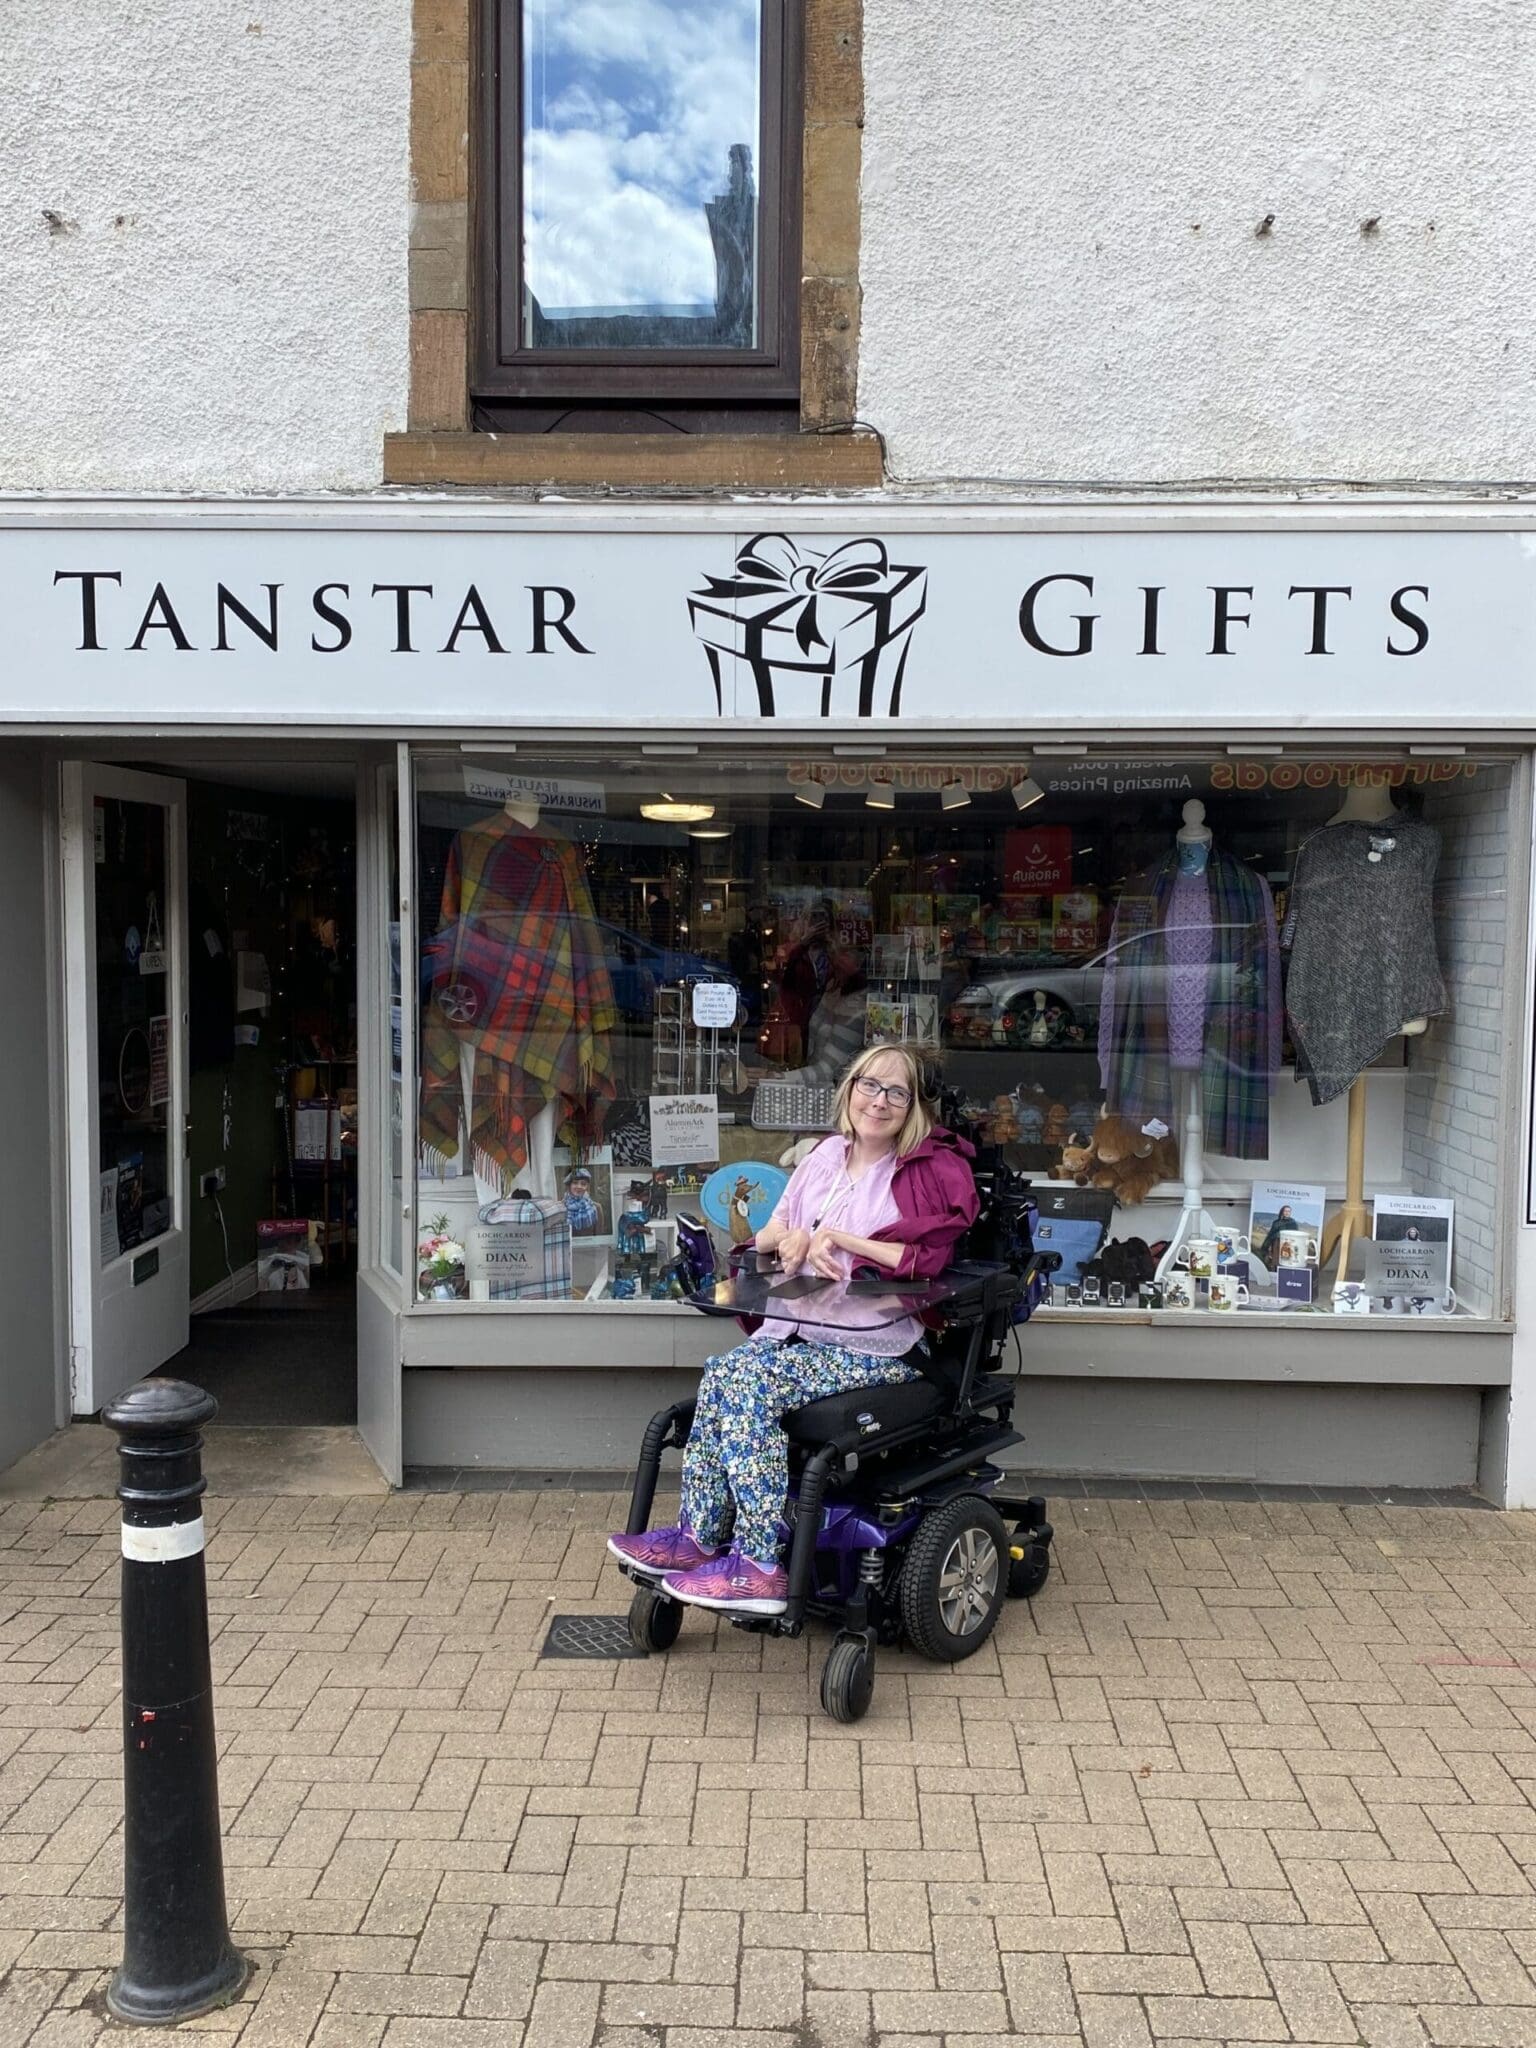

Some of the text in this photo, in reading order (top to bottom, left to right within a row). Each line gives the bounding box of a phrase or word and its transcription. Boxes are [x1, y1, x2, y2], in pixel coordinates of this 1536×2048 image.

[54, 570, 1429, 656] TANSTAR GIFTS
[1012, 869, 1060, 882] AURORA
[485, 1253, 527, 1262] DIANA
[1387, 1269, 1429, 1279] DIANA
